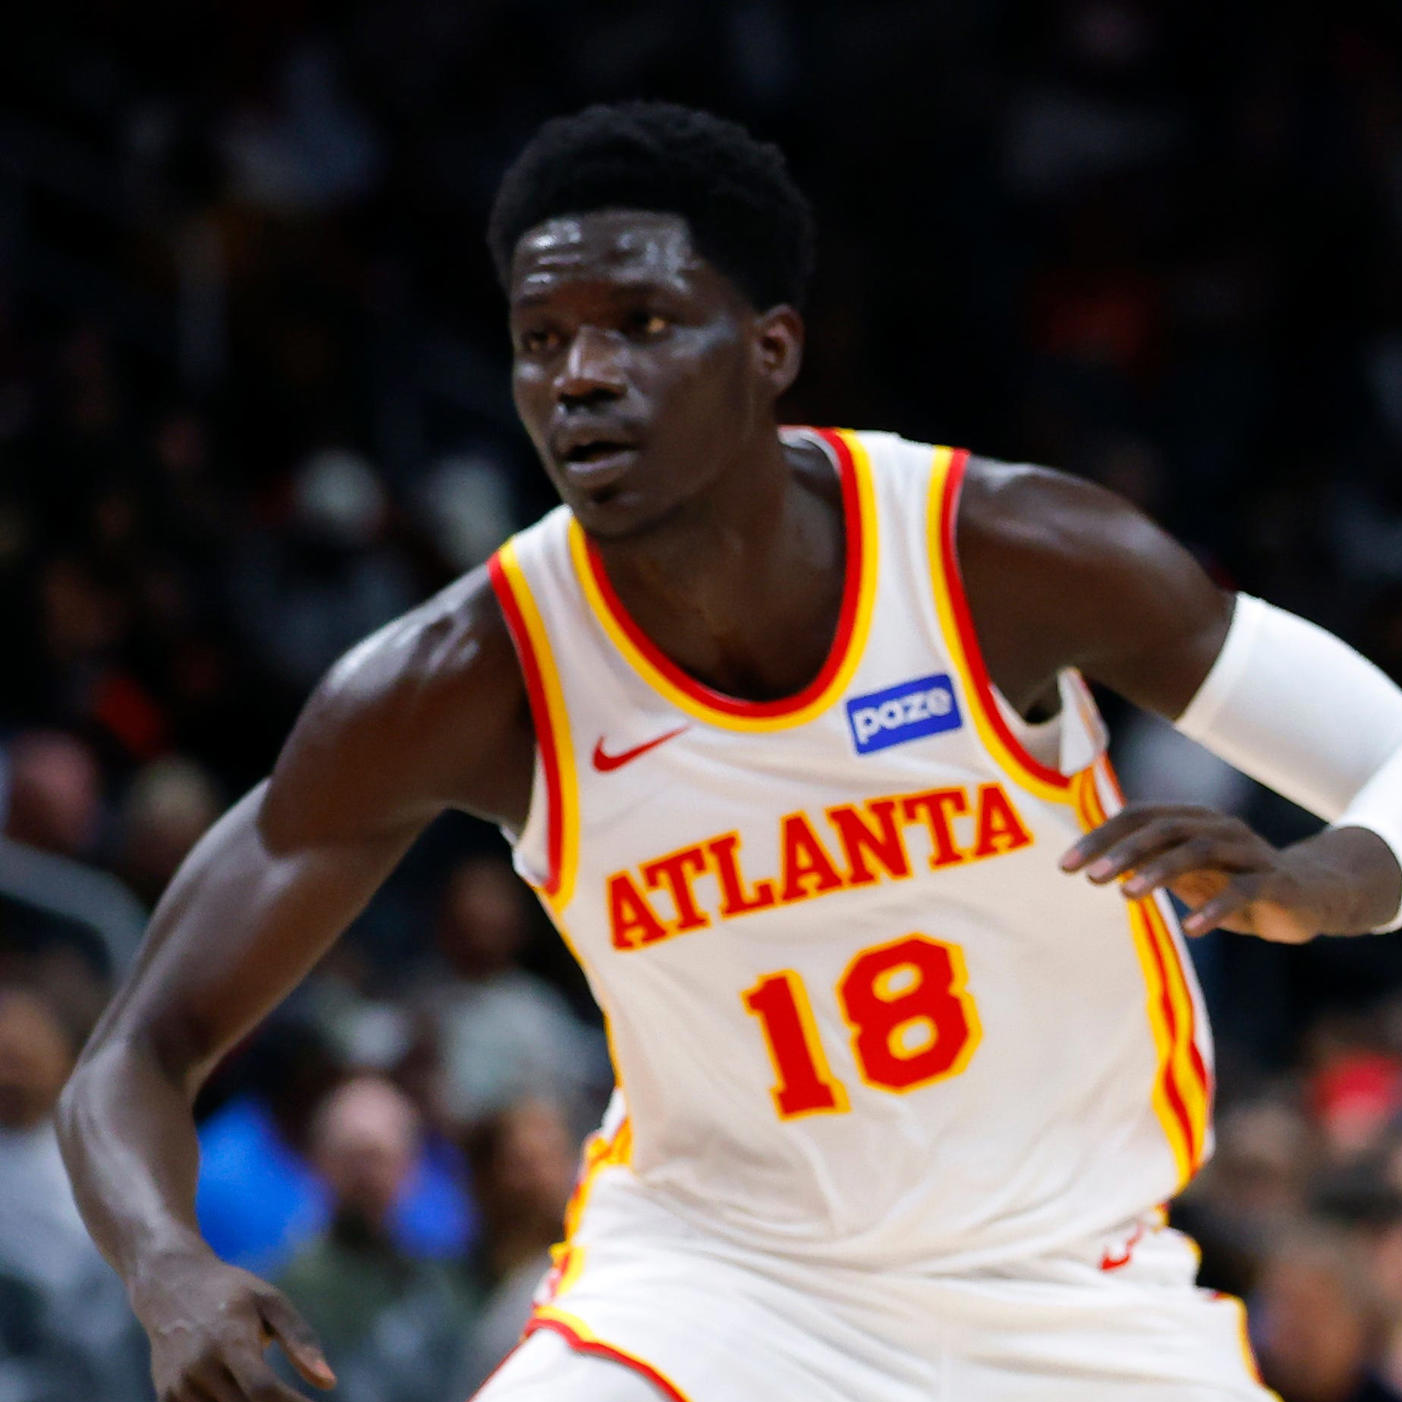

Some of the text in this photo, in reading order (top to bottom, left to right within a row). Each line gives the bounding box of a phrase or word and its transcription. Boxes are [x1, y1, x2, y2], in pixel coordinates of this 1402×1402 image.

[853, 686, 953, 745] paze
[604, 782, 1034, 952] ATLANTA
[741, 932, 983, 1122] 18
